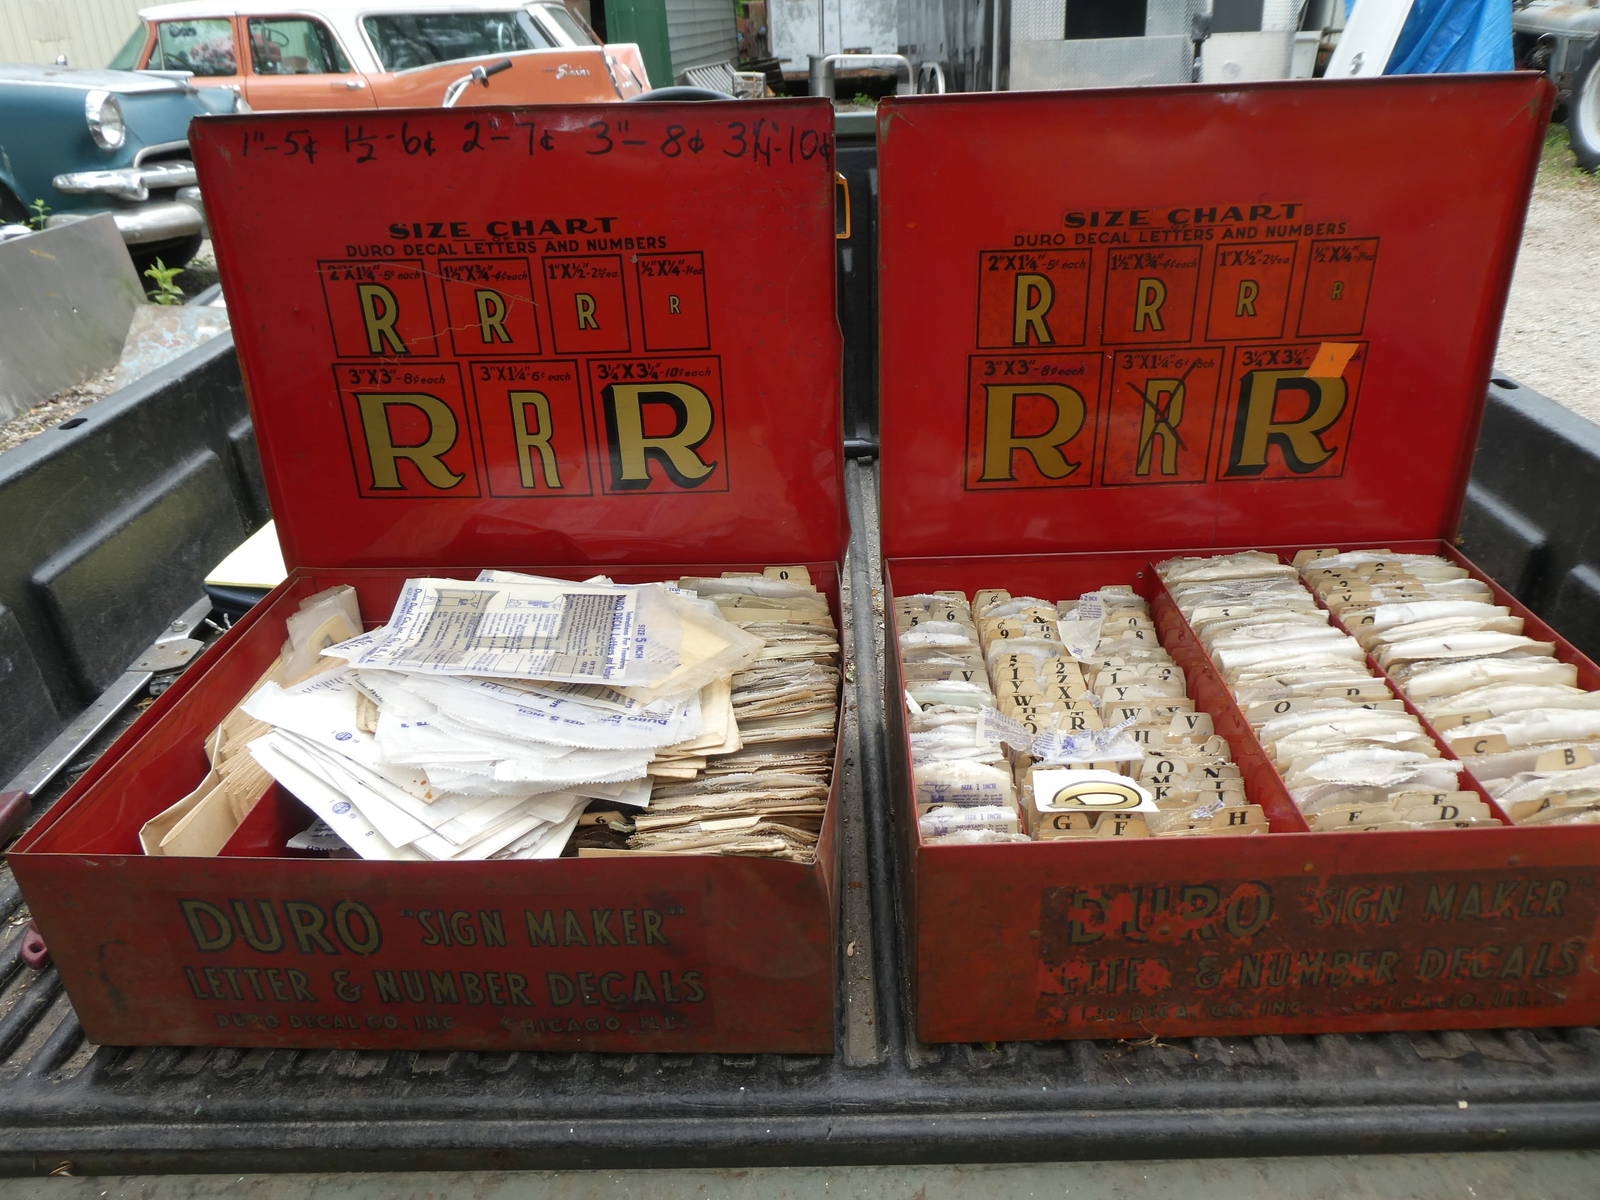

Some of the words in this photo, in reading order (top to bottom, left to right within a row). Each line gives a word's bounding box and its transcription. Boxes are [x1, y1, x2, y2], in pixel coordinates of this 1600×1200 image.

[1064, 210, 1150, 229] SIZE
[1167, 203, 1304, 225] CHART
[388, 221, 471, 239] SIZE
[485, 216, 618, 236] CHART
[1013, 232, 1066, 248] DURO
[1074, 231, 1132, 245] DECAL
[1138, 227, 1215, 243] LETTERS
[1221, 226, 1259, 240] AND
[1265, 221, 1348, 238] NUMBERS
[345, 244, 396, 257] DURO
[400, 242, 458, 256] DECAL
[463, 240, 537, 254] LETTERS
[545, 239, 580, 252] AND
[586, 235, 668, 251] NUMBERS
[1235, 279, 1260, 318] R
[1331, 280, 1345, 300] R
[574, 292, 601, 330] R
[668, 295, 682, 315] R
[1012, 271, 1056, 346] R
[1133, 277, 1166, 332] R
[356, 281, 412, 355] R
[473, 288, 514, 344] R
[420, 373, 446, 384] each
[1058, 365, 1085, 376] each
[1223, 367, 1349, 477] R
[351, 391, 466, 491] R
[507, 389, 564, 489] R
[600, 381, 719, 491] R
[975, 383, 1088, 483] R
[911, 616, 919, 626] 5
[946, 610, 955, 621] 6
[1000, 629, 1009, 639] 9
[961, 670, 974, 682] V
[1056, 662, 1065, 674] 2
[1010, 680, 1024, 693] Y
[1058, 685, 1072, 699] X
[1115, 686, 1129, 700] Y
[1013, 695, 1033, 706] W
[1071, 716, 1085, 730] R
[1184, 715, 1199, 729] V
[1474, 739, 1488, 754] C
[1564, 748, 1576, 765] B
[1154, 786, 1171, 801] K
[1053, 814, 1072, 830] G
[1228, 810, 1248, 826] H
[1439, 805, 1460, 820] D
[1113, 821, 1128, 836] F
[177, 897, 384, 956] DURO
[1194, 955, 1226, 990] &
[1236, 949, 1402, 989] NUMBER
[1417, 941, 1586, 980] DECALS
[183, 965, 321, 1003] LETTER
[331, 968, 363, 1003] &
[373, 968, 537, 1008] NUMBER
[546, 969, 708, 1007] DECALS
[215, 1012, 281, 1030] DURO
[287, 1013, 361, 1031] DECAL
